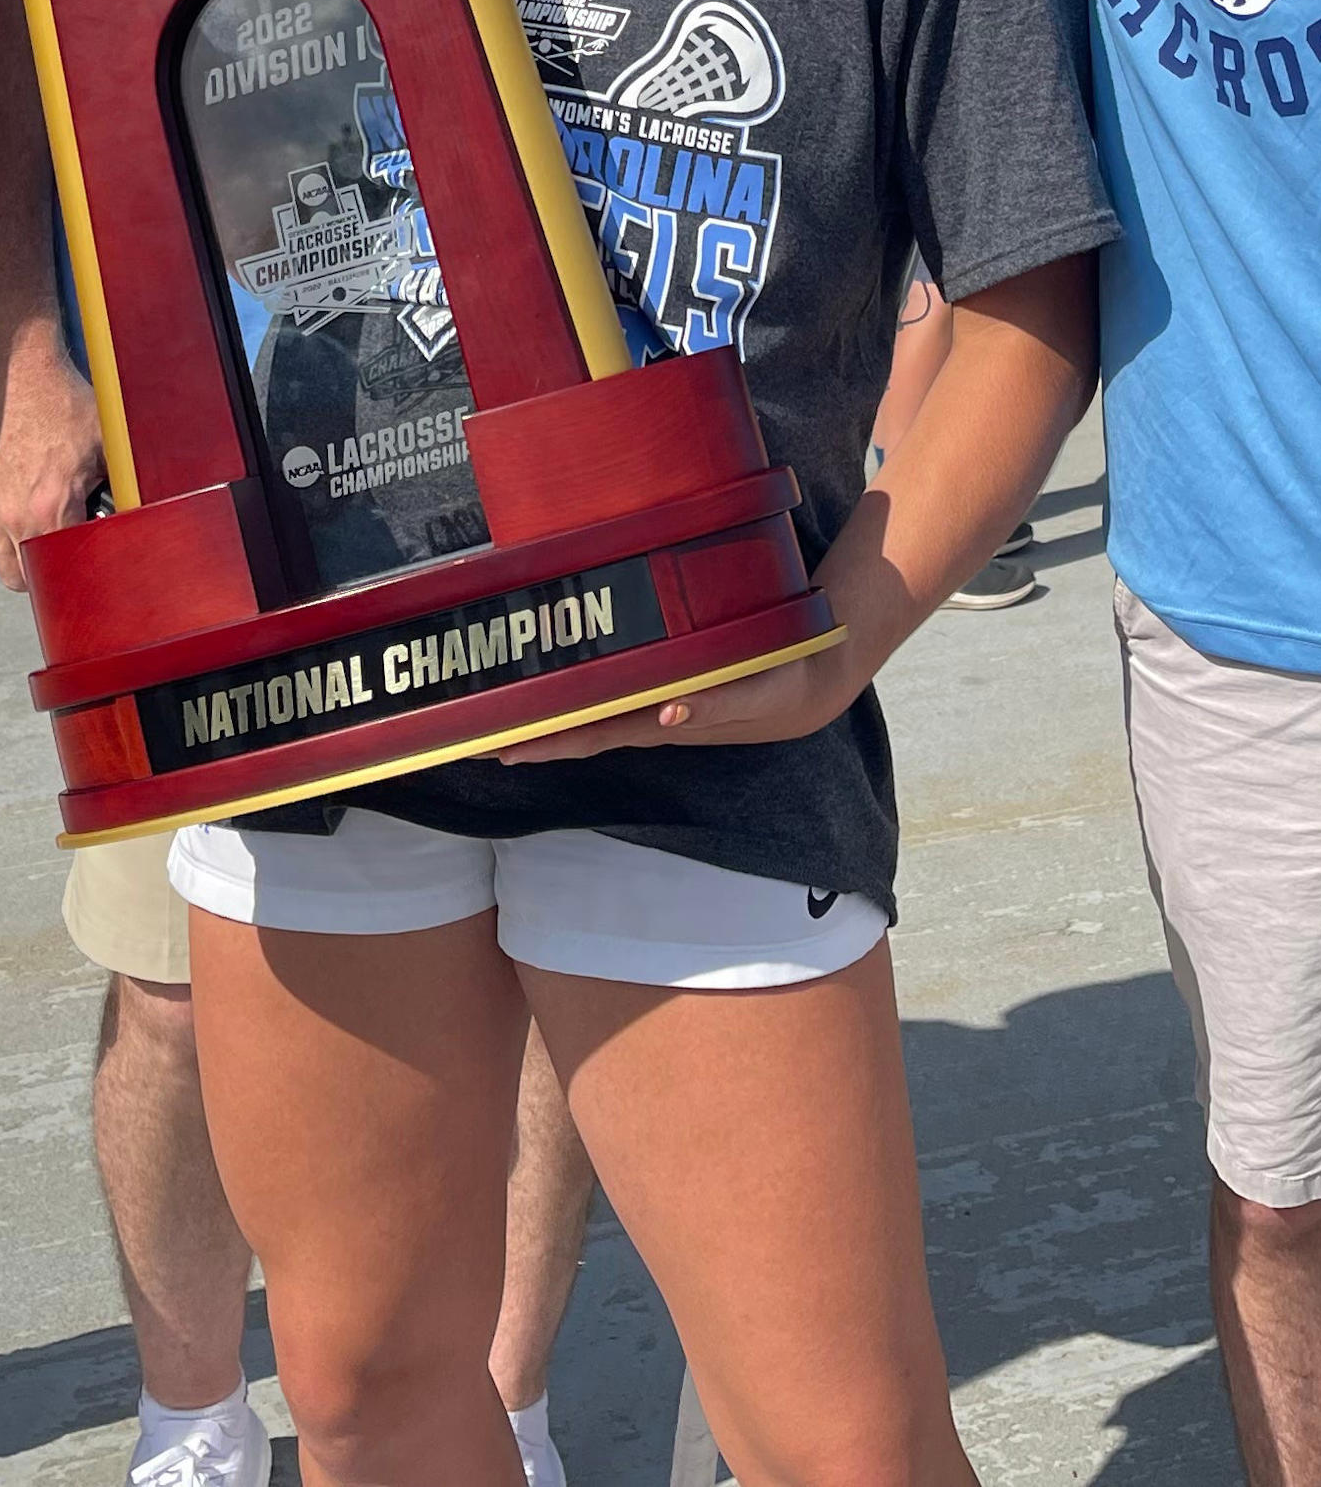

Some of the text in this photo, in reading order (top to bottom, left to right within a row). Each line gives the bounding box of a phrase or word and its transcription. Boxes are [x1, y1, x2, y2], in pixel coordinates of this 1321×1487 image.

[236, 1, 314, 51] 2022
[515, 0, 617, 31] AMPIONSHIP
[204, 29, 348, 106] DIVISION
[549, 98, 735, 155] WOMEN'S LACROSSE
[255, 230, 394, 287] CHAMPIONSHIP
[289, 220, 360, 255] LACROSSE
[182, 586, 615, 748] NATIONAL CHAMPION
